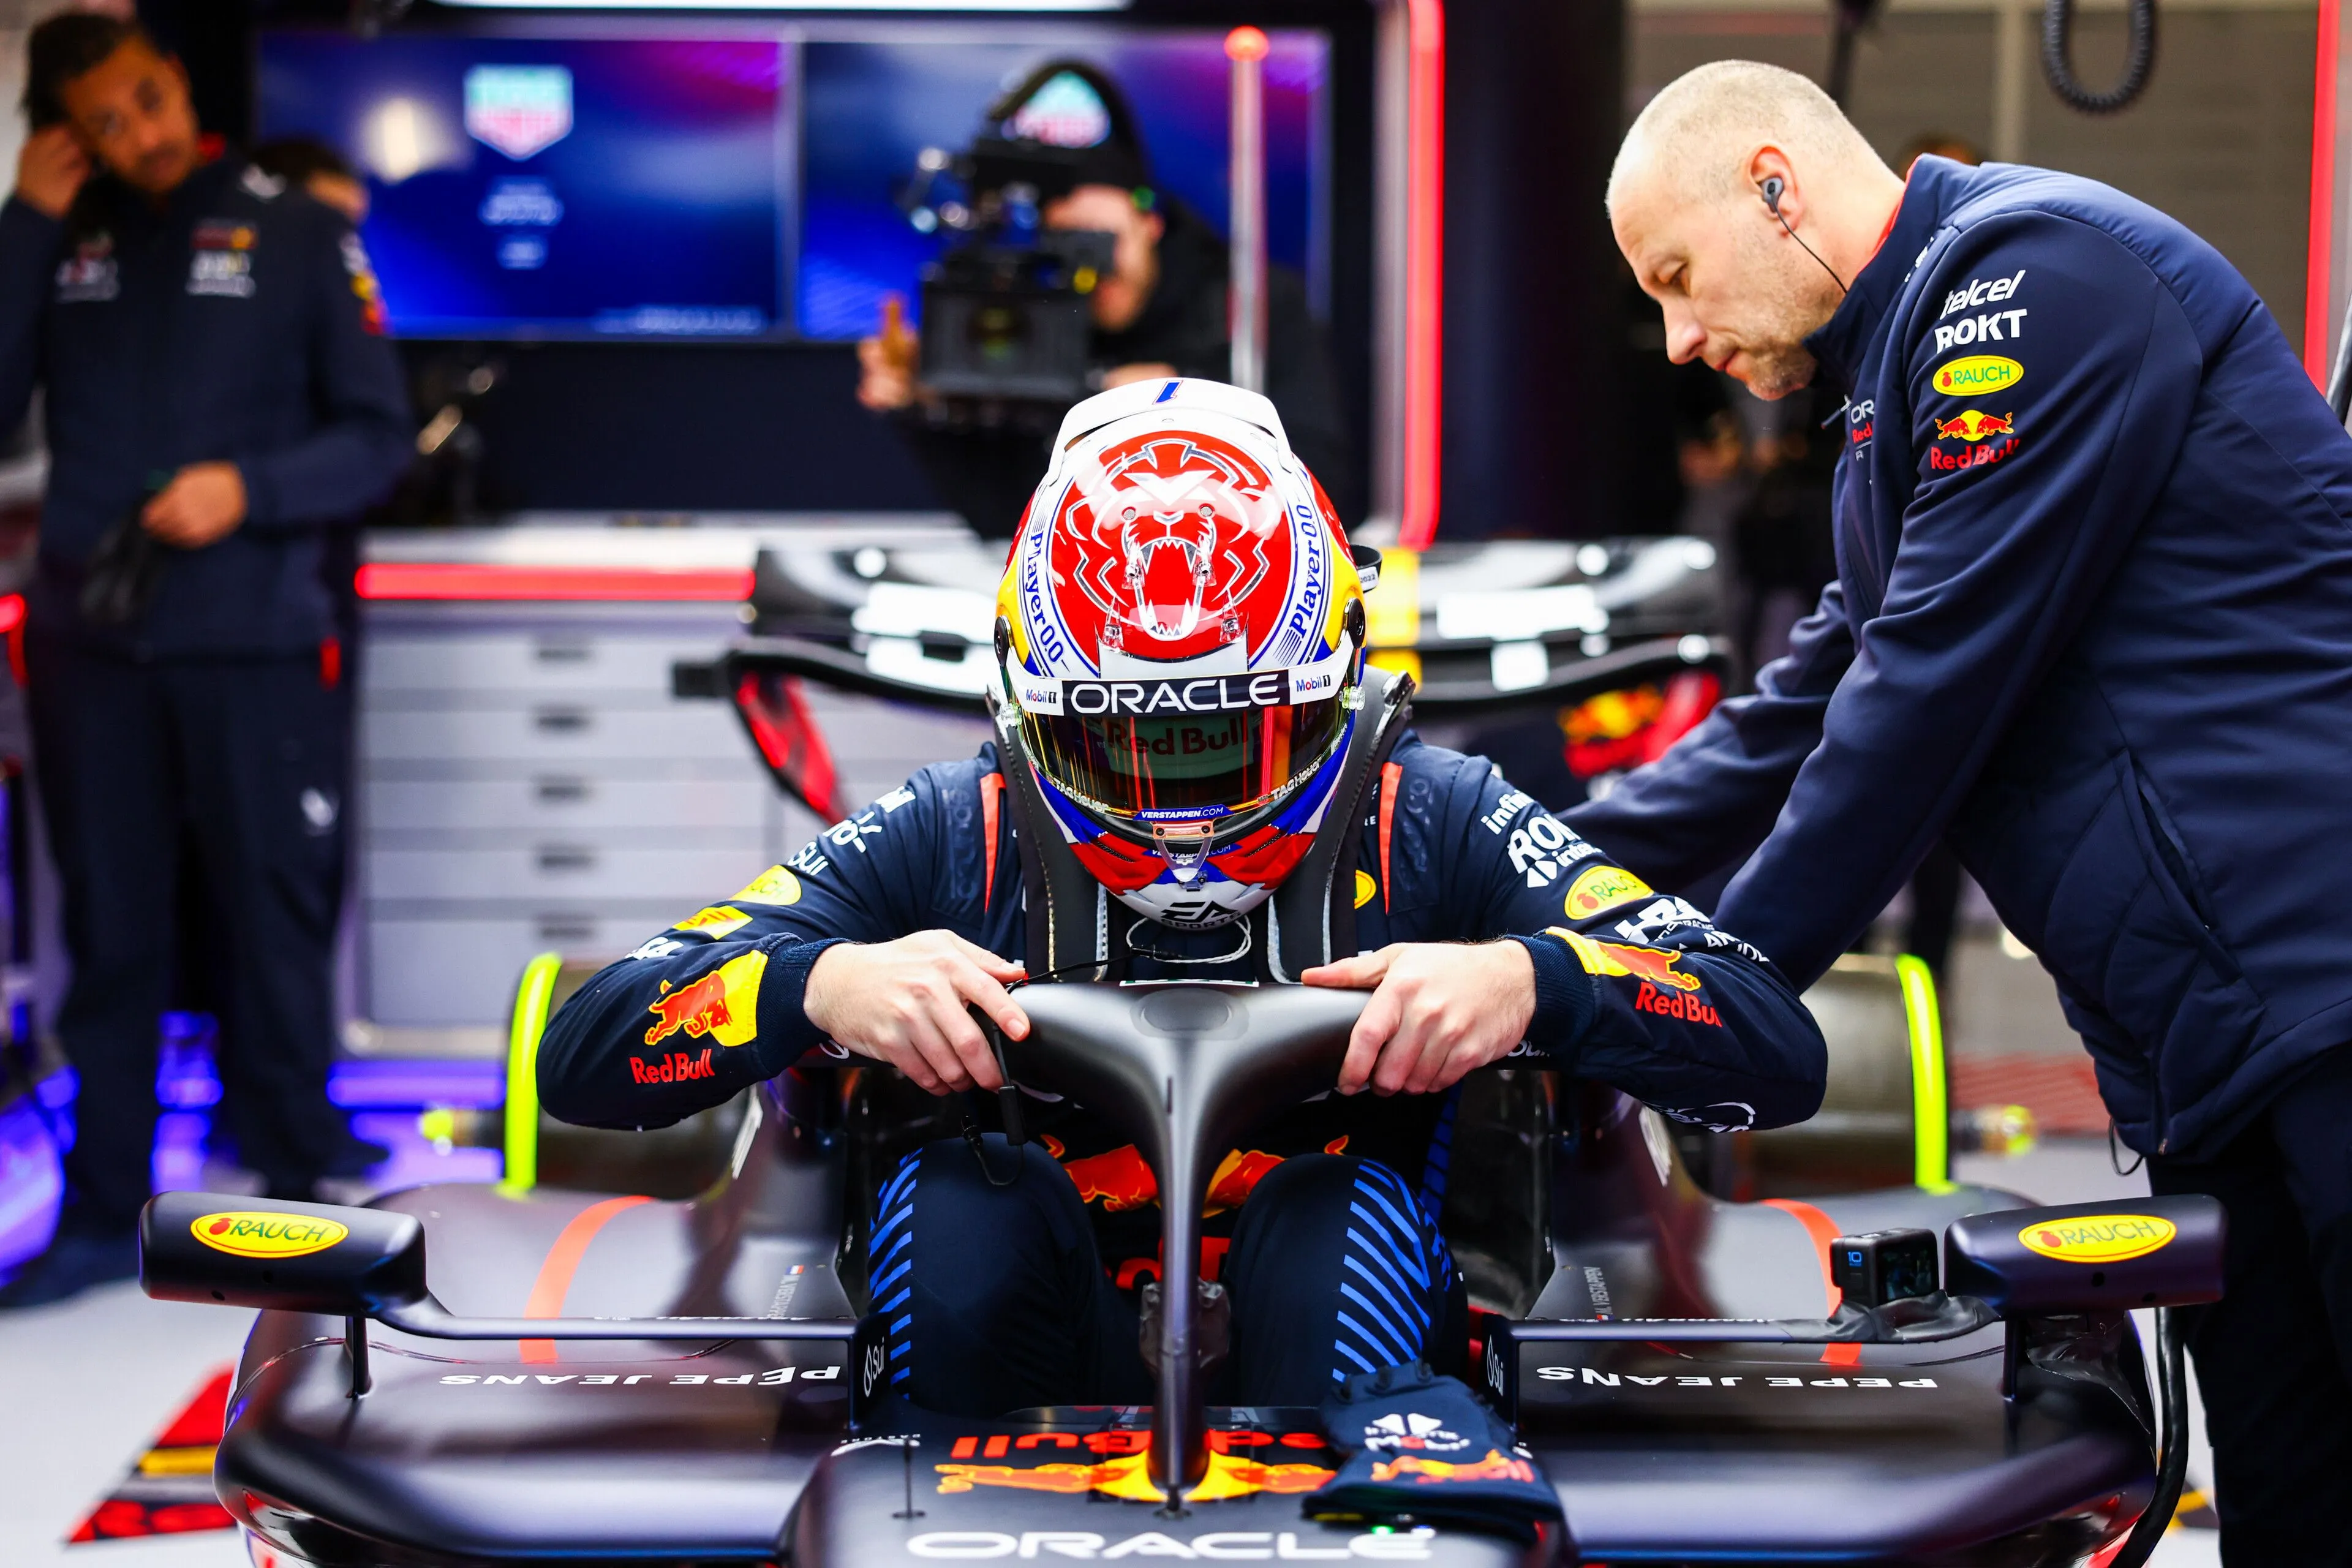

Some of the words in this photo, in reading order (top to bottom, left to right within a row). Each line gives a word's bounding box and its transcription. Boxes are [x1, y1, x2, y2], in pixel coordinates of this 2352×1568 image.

[1939, 270, 2026, 320] telcel
[1934, 309, 2027, 354] ROKT
[1954, 365, 2010, 385] RAUCH
[1931, 445, 1972, 469] Red
[1025, 530, 1046, 625] Player
[1289, 540, 1322, 639] Player
[1026, 689, 1047, 703] Mobil
[1071, 674, 1281, 714] ORACLE
[1295, 677, 1322, 692] Mobil
[1141, 807, 1224, 819] VERSTAPPEN.COM
[1161, 900, 1238, 922] EA
[1635, 981, 1683, 1019] Red
[630, 1054, 673, 1084] Red
[674, 1049, 715, 1082] Bull
[229, 1219, 330, 1243] RAUCH
[2060, 1221, 2157, 1245] RAUCH
[1847, 1251, 1862, 1263] 10
[439, 1374, 652, 1385] JEANS
[669, 1366, 842, 1385] PEPE
[1536, 1366, 1743, 1388] JEANS
[1765, 1377, 1939, 1389] PEPE
[907, 1531, 1435, 1559] ORACLE
